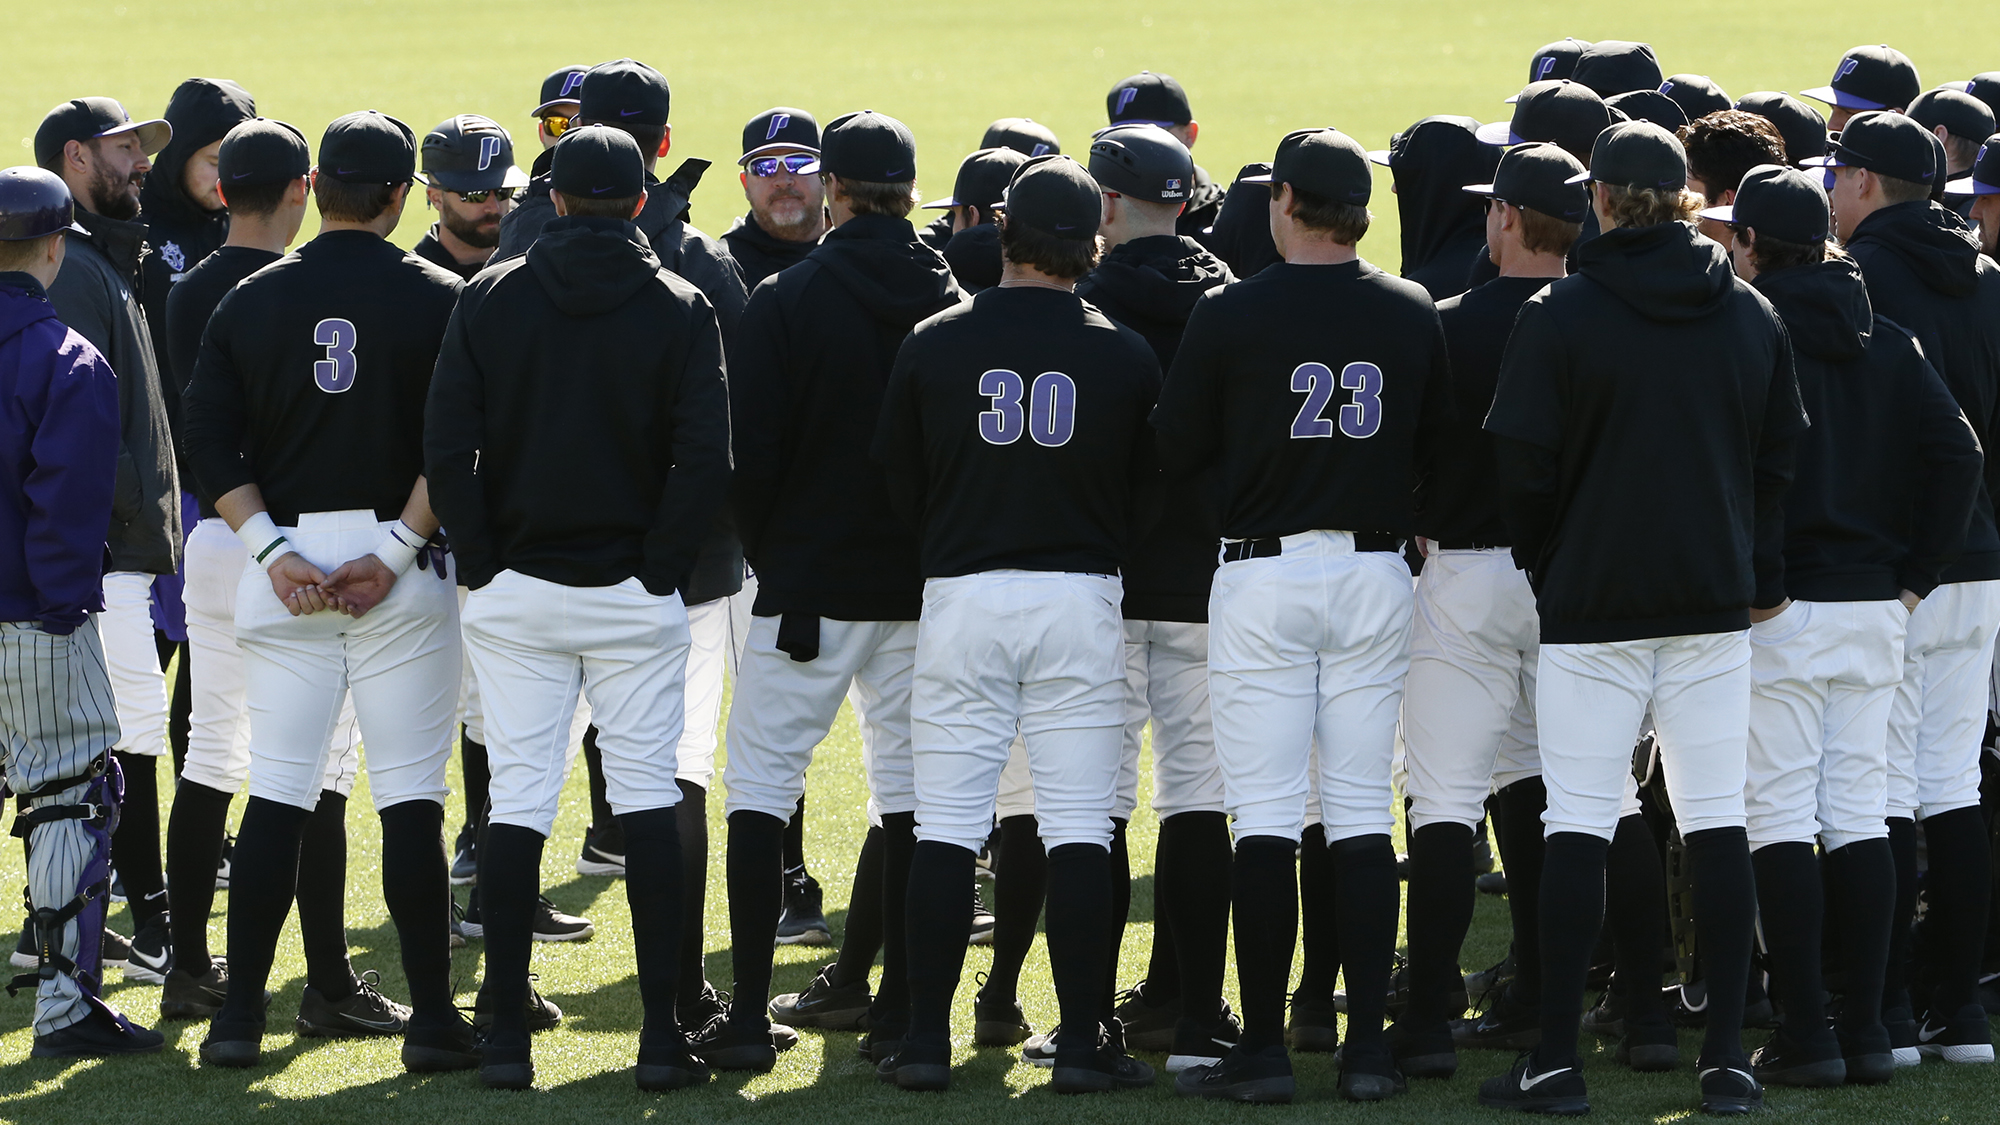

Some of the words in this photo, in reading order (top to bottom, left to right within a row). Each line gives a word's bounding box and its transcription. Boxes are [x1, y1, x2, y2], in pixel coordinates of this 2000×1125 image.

[1536, 57, 1556, 81] P
[1834, 57, 1859, 82] P
[560, 71, 586, 96] P
[1115, 87, 1138, 115] P
[766, 113, 790, 140] P
[477, 136, 501, 171] P
[1161, 190, 1183, 198] Wilson
[314, 317, 357, 394] 3
[978, 368, 1076, 448] 30
[1290, 361, 1383, 439] 23
